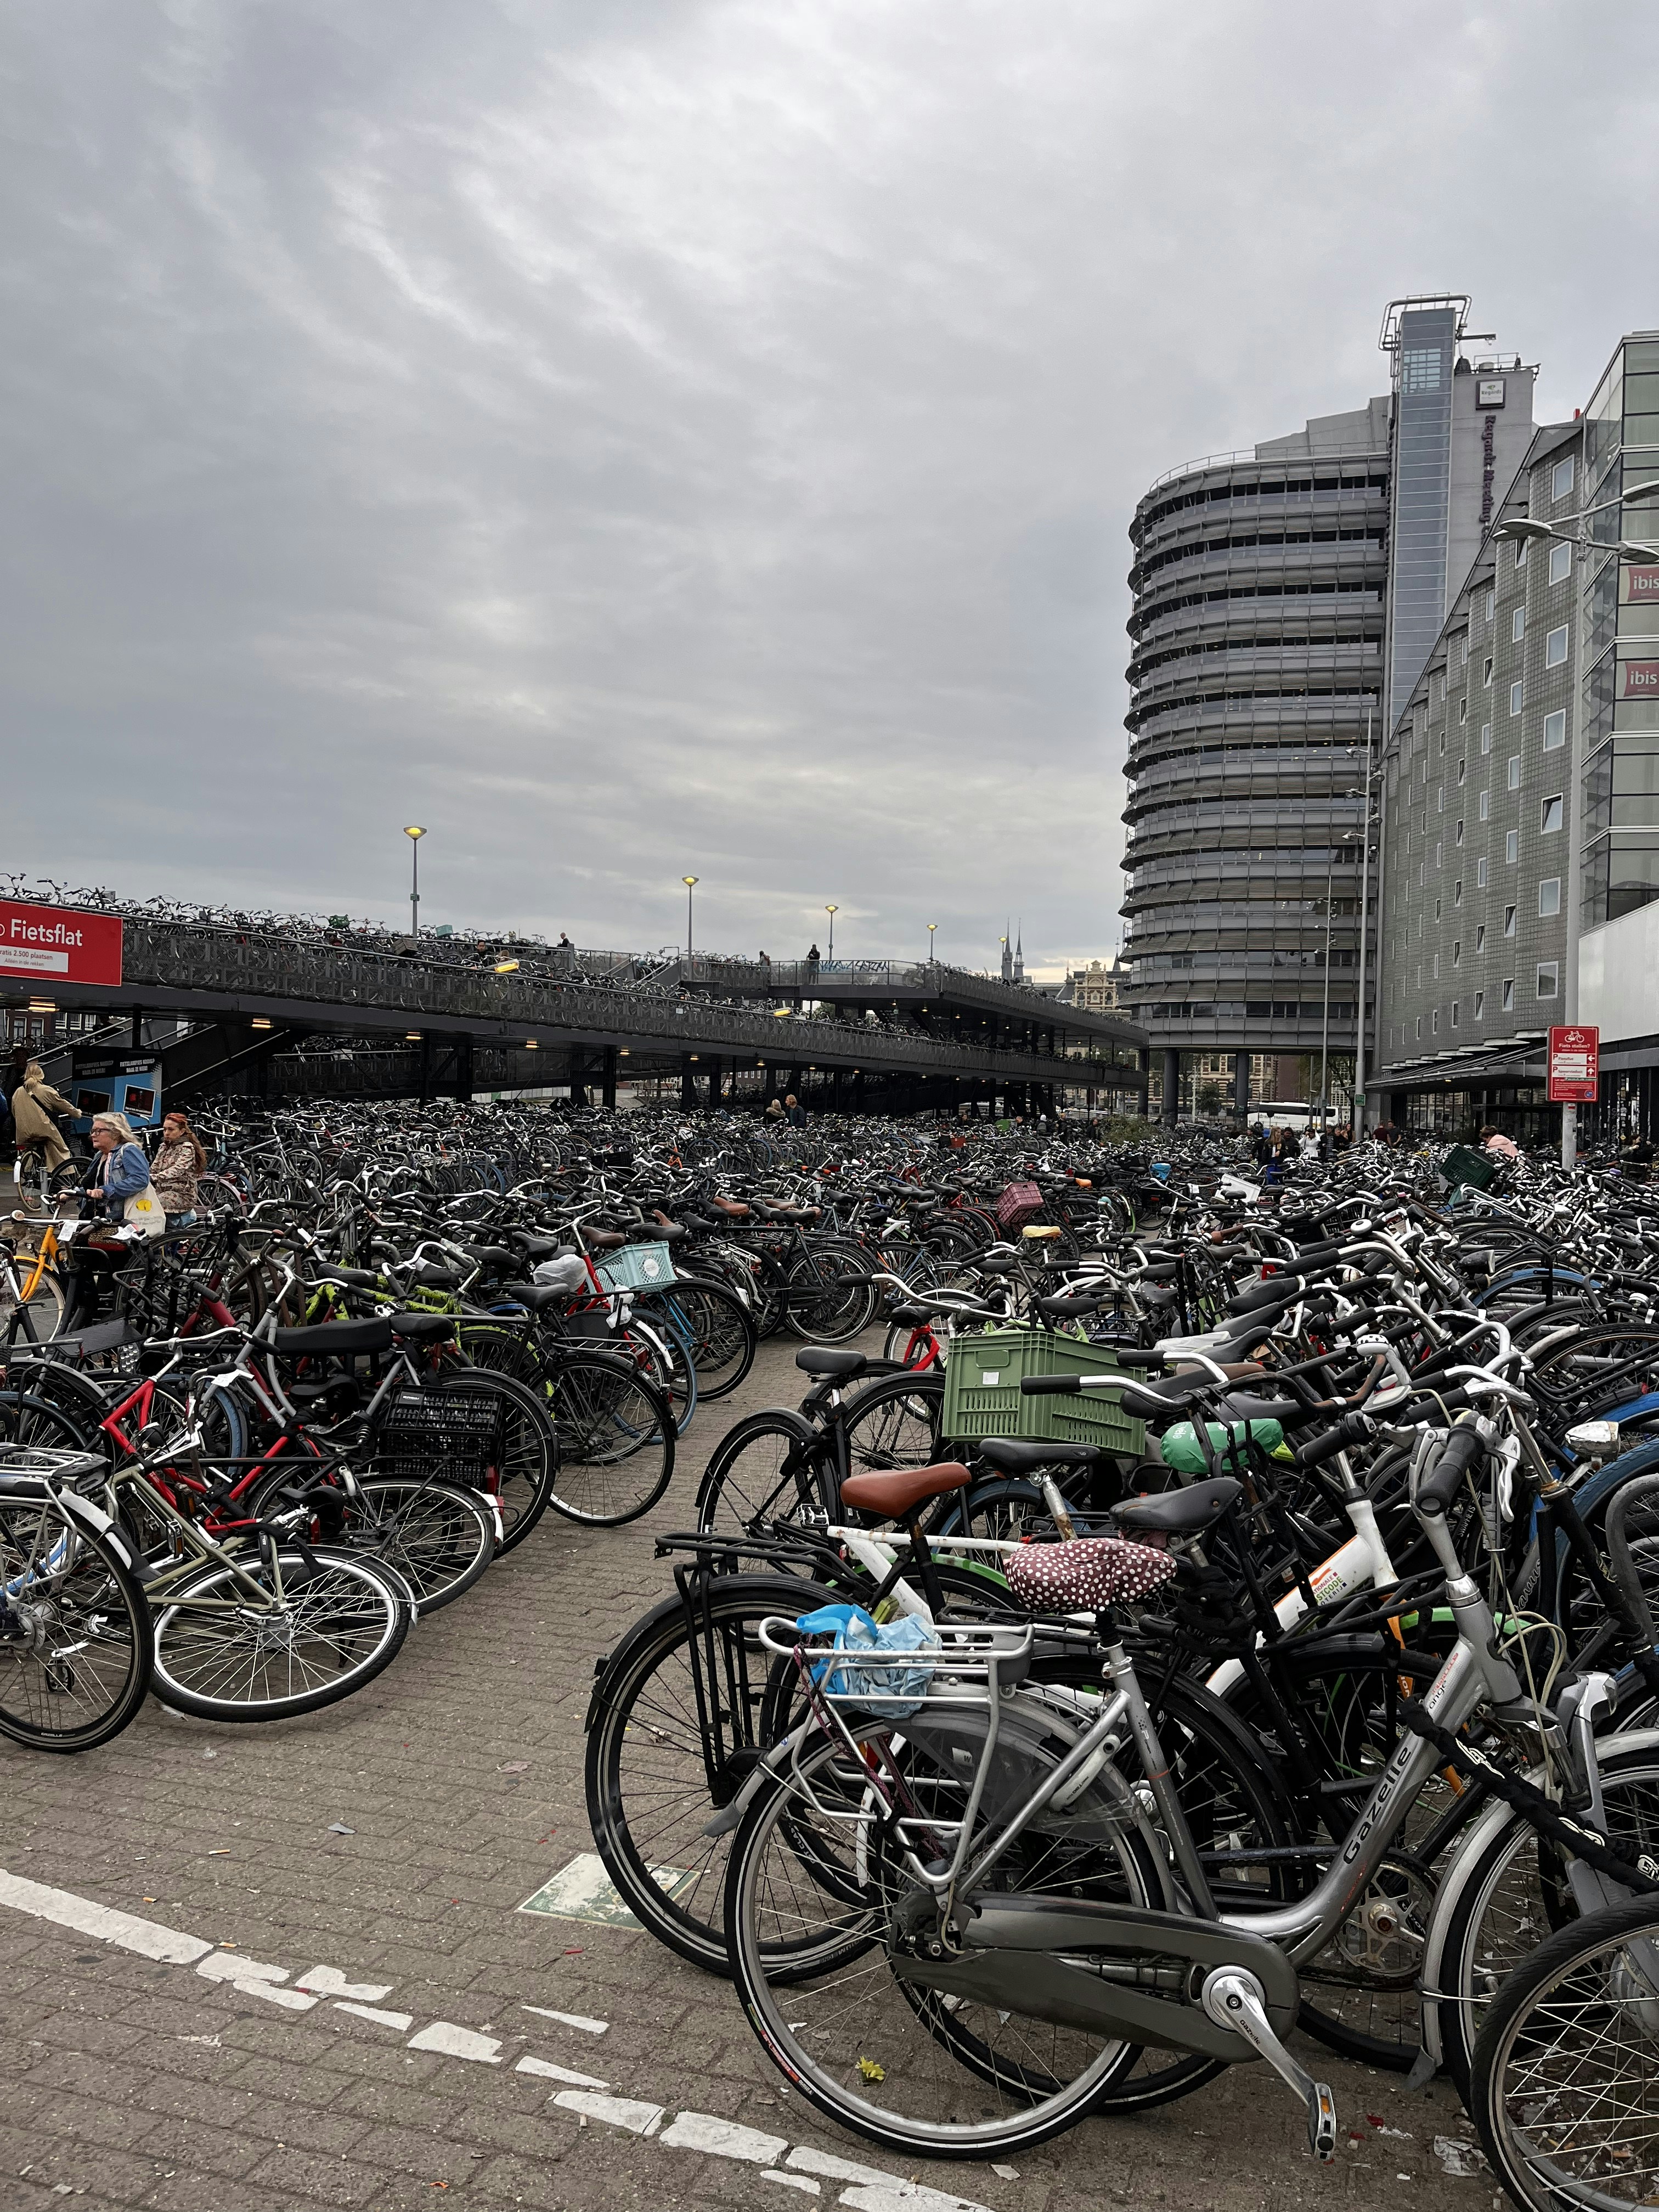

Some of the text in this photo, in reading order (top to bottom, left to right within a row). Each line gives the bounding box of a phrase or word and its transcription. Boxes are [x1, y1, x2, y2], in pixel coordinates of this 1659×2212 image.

[1479, 470, 1494, 522] Meeting
[1634, 575, 1659, 589] ibis
[1630, 670, 1657, 685] ibis
[11, 918, 82, 946] Fietsflat
[30, 952, 53, 960] plaatsen
[1457, 1505, 1476, 1537] SWAPFIETS
[1321, 1585, 1343, 1606] OTERIJ
[1344, 1747, 1412, 1865] Gazelle
